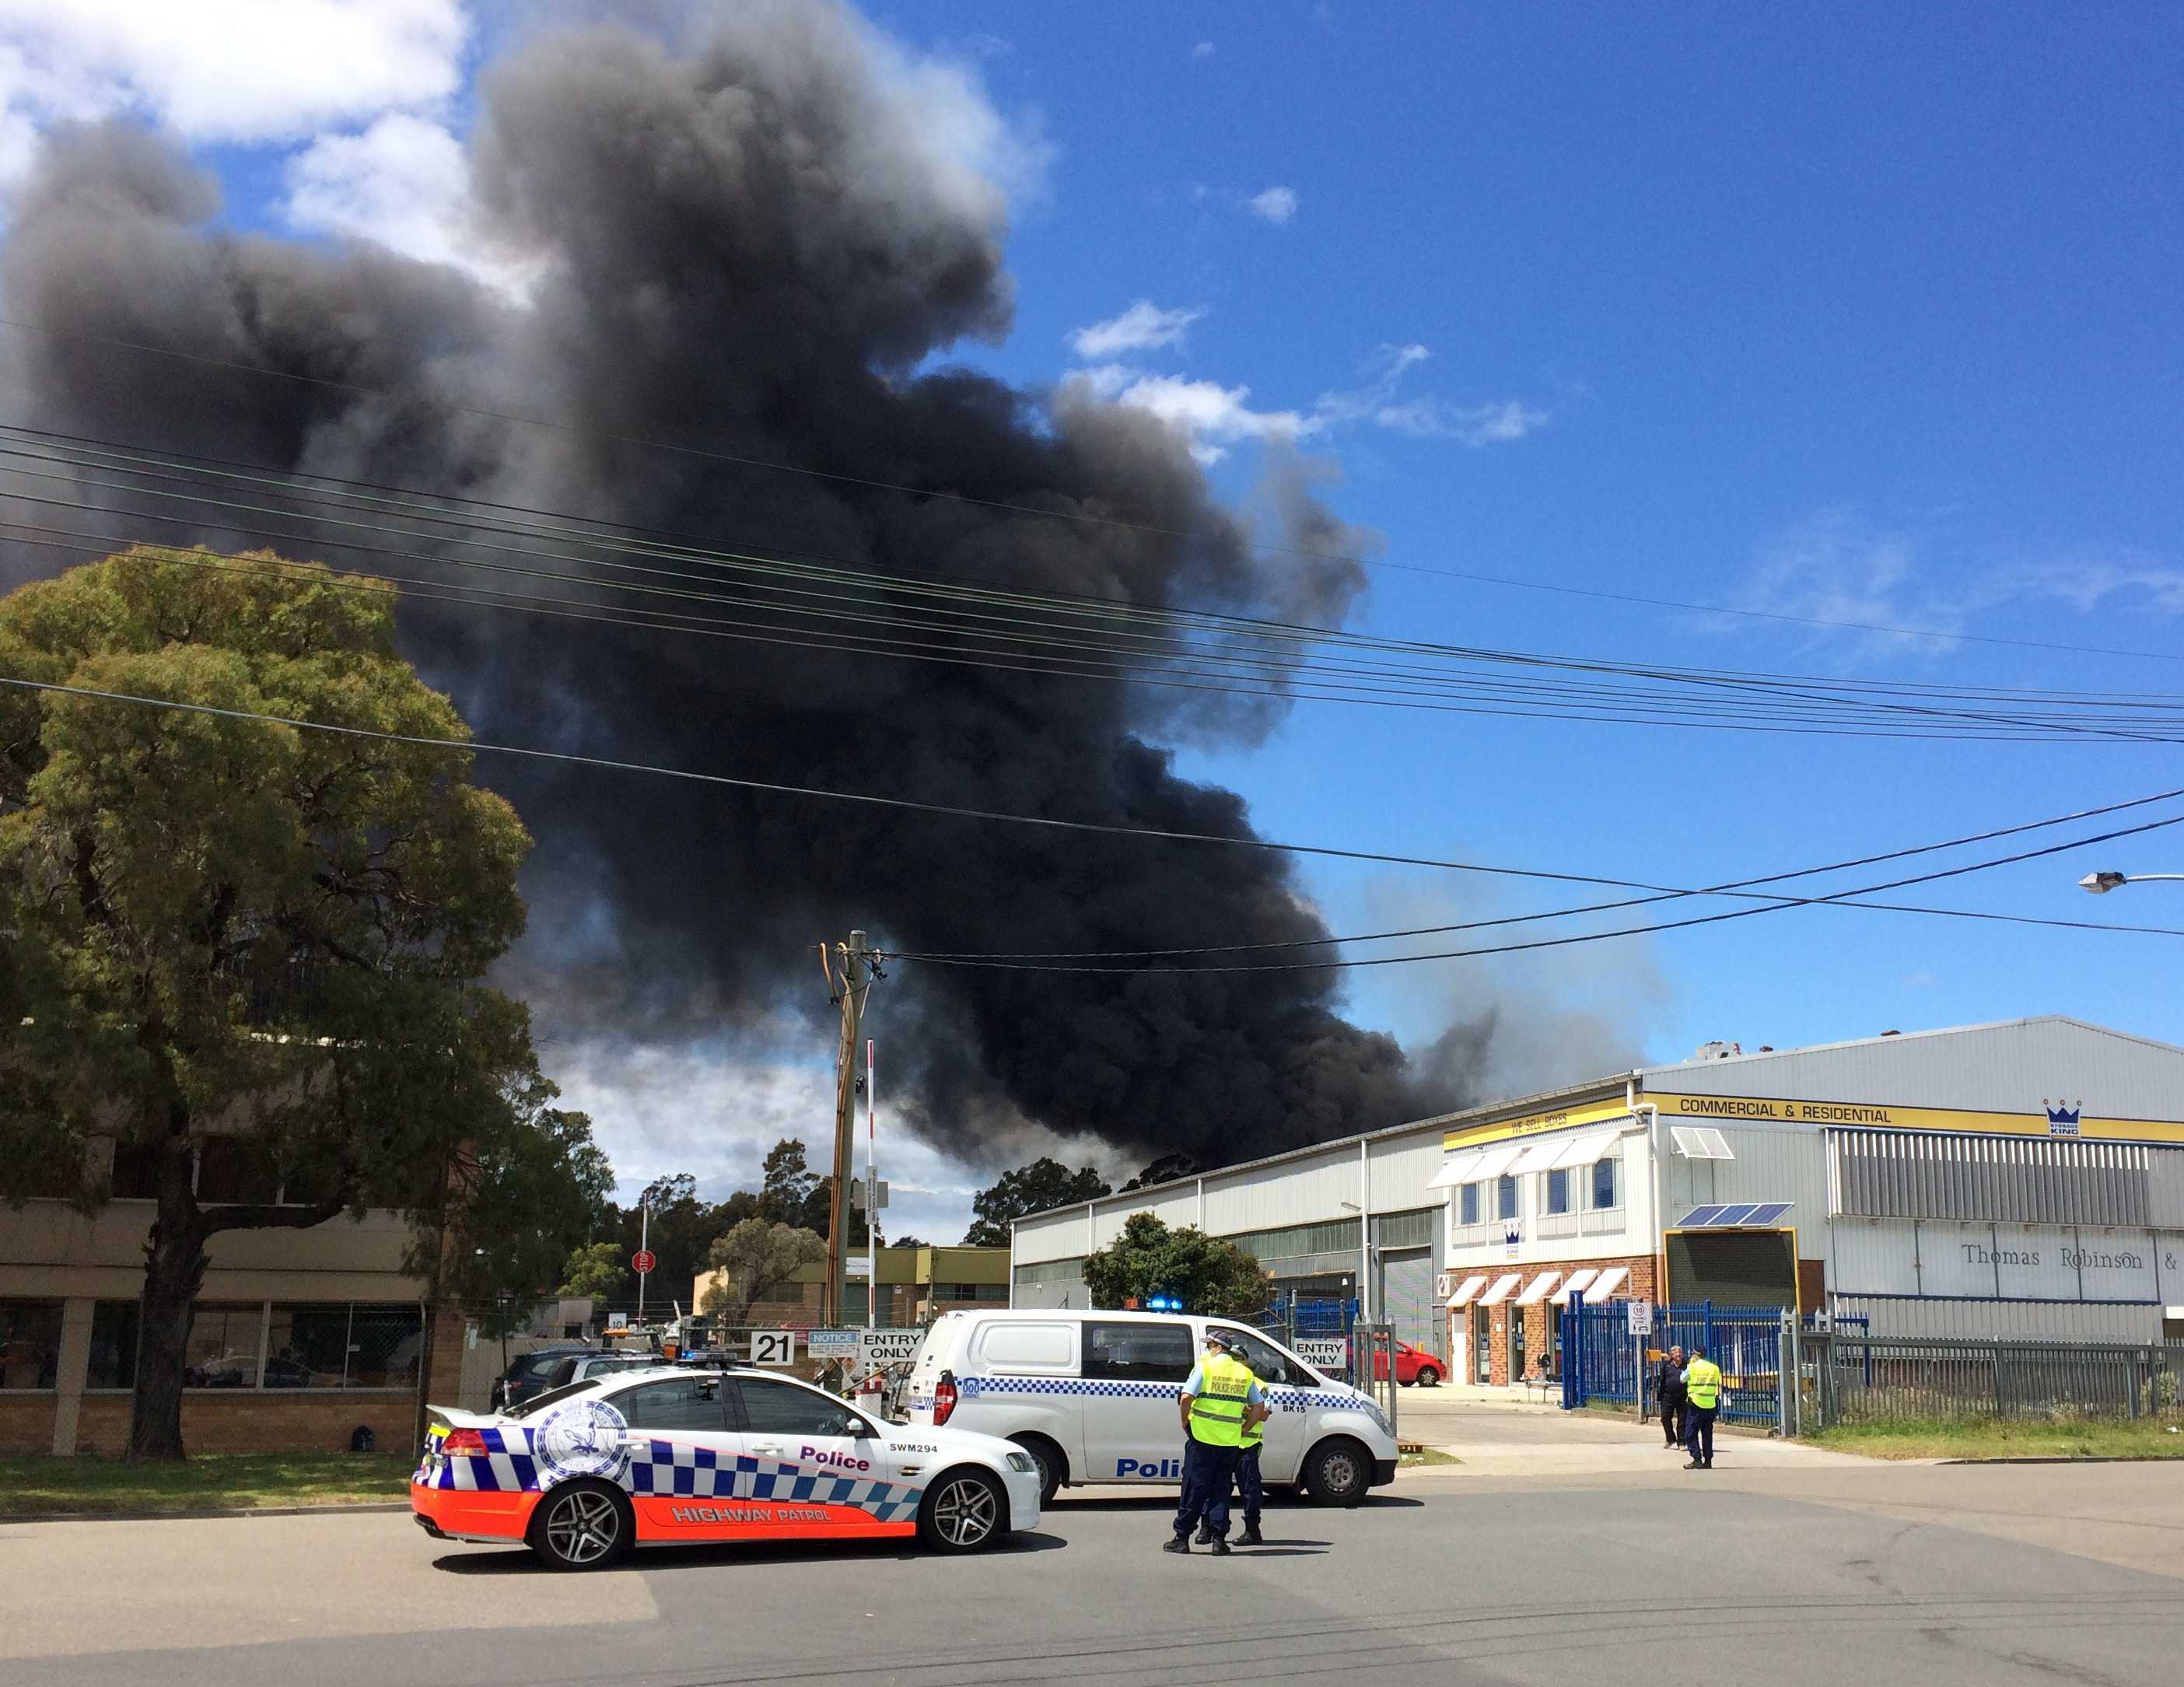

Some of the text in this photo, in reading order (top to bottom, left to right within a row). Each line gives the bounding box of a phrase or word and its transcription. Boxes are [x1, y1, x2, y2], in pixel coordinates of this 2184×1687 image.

[1680, 1098, 1892, 1122] COMMERCIAL & RESIDENTIAL
[1511, 1112, 1567, 1133] WE SELL BOXES
[639, 1251, 649, 1272] STOP
[1962, 1244, 2179, 1270] Thomas Robinson &
[813, 1333, 852, 1343] NOTICE
[864, 1335, 921, 1345] ENTRY
[757, 1335, 789, 1362] 21
[870, 1347, 914, 1359] ONLY
[1297, 1343, 1343, 1353] ENTRY
[1301, 1355, 1337, 1365] ONLY
[1211, 1381, 1230, 1393] POLICE
[890, 1443, 938, 1453] SWM294
[800, 1445, 870, 1472] Police
[1116, 1458, 1180, 1478] Poli
[670, 1507, 831, 1523] HIGHWAY PATROL
